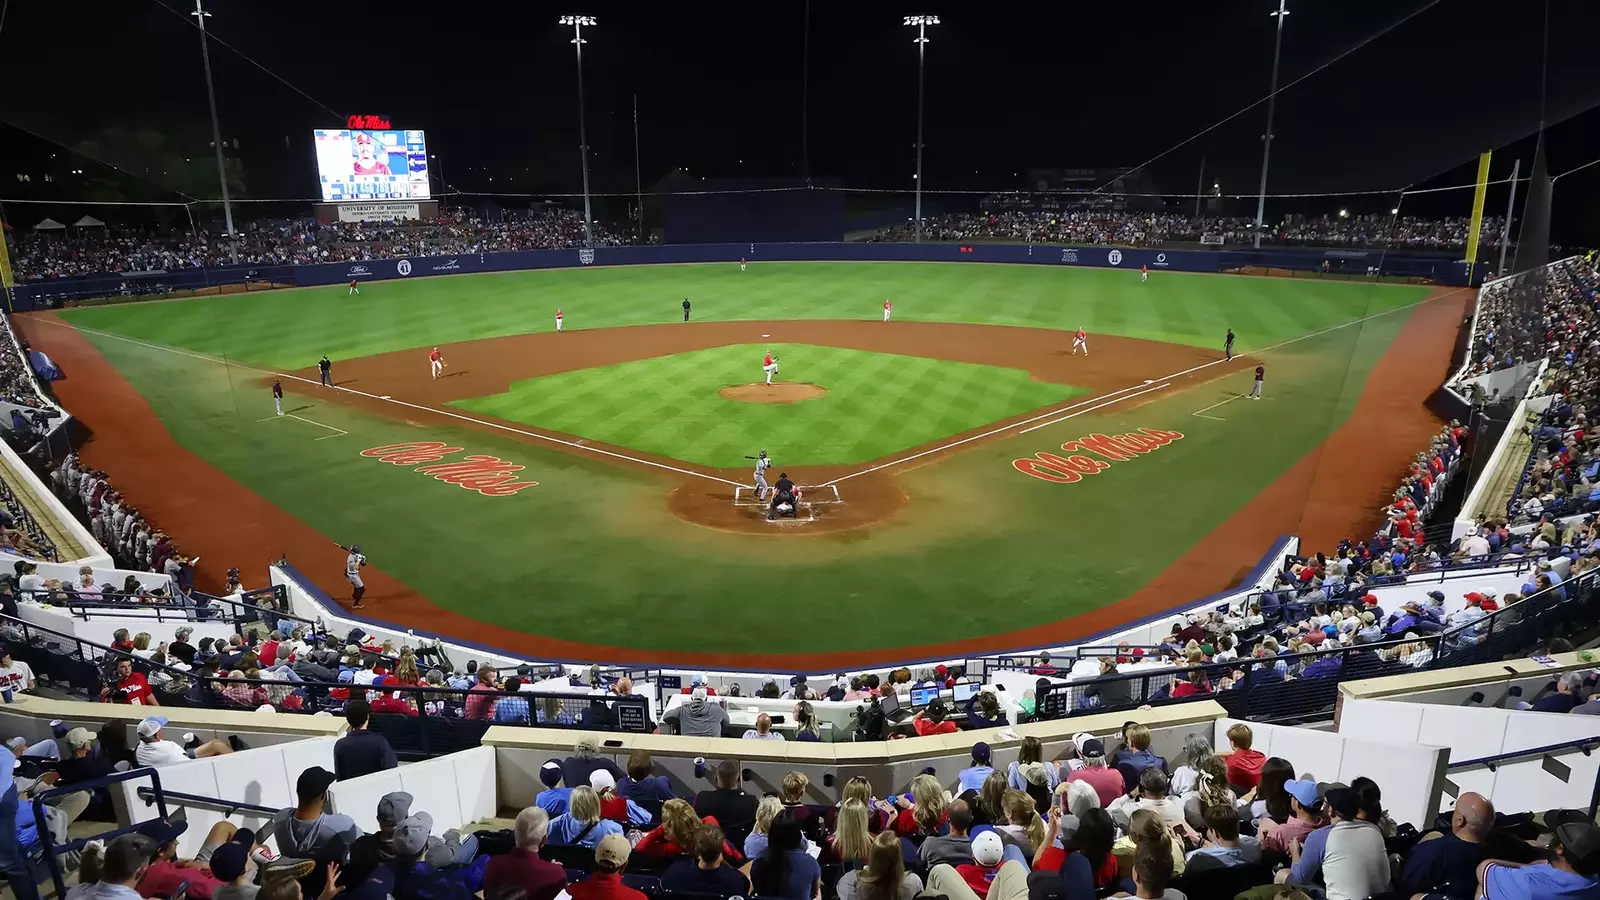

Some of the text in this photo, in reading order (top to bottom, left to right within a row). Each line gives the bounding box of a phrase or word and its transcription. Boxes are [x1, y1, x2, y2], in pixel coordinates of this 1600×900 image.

[347, 115, 391, 129] Ole Miss
[1111, 254, 1119, 263] 11
[400, 264, 409, 273] 41
[1012, 427, 1185, 484] Ole Miss
[359, 441, 540, 496] Ole Miss
